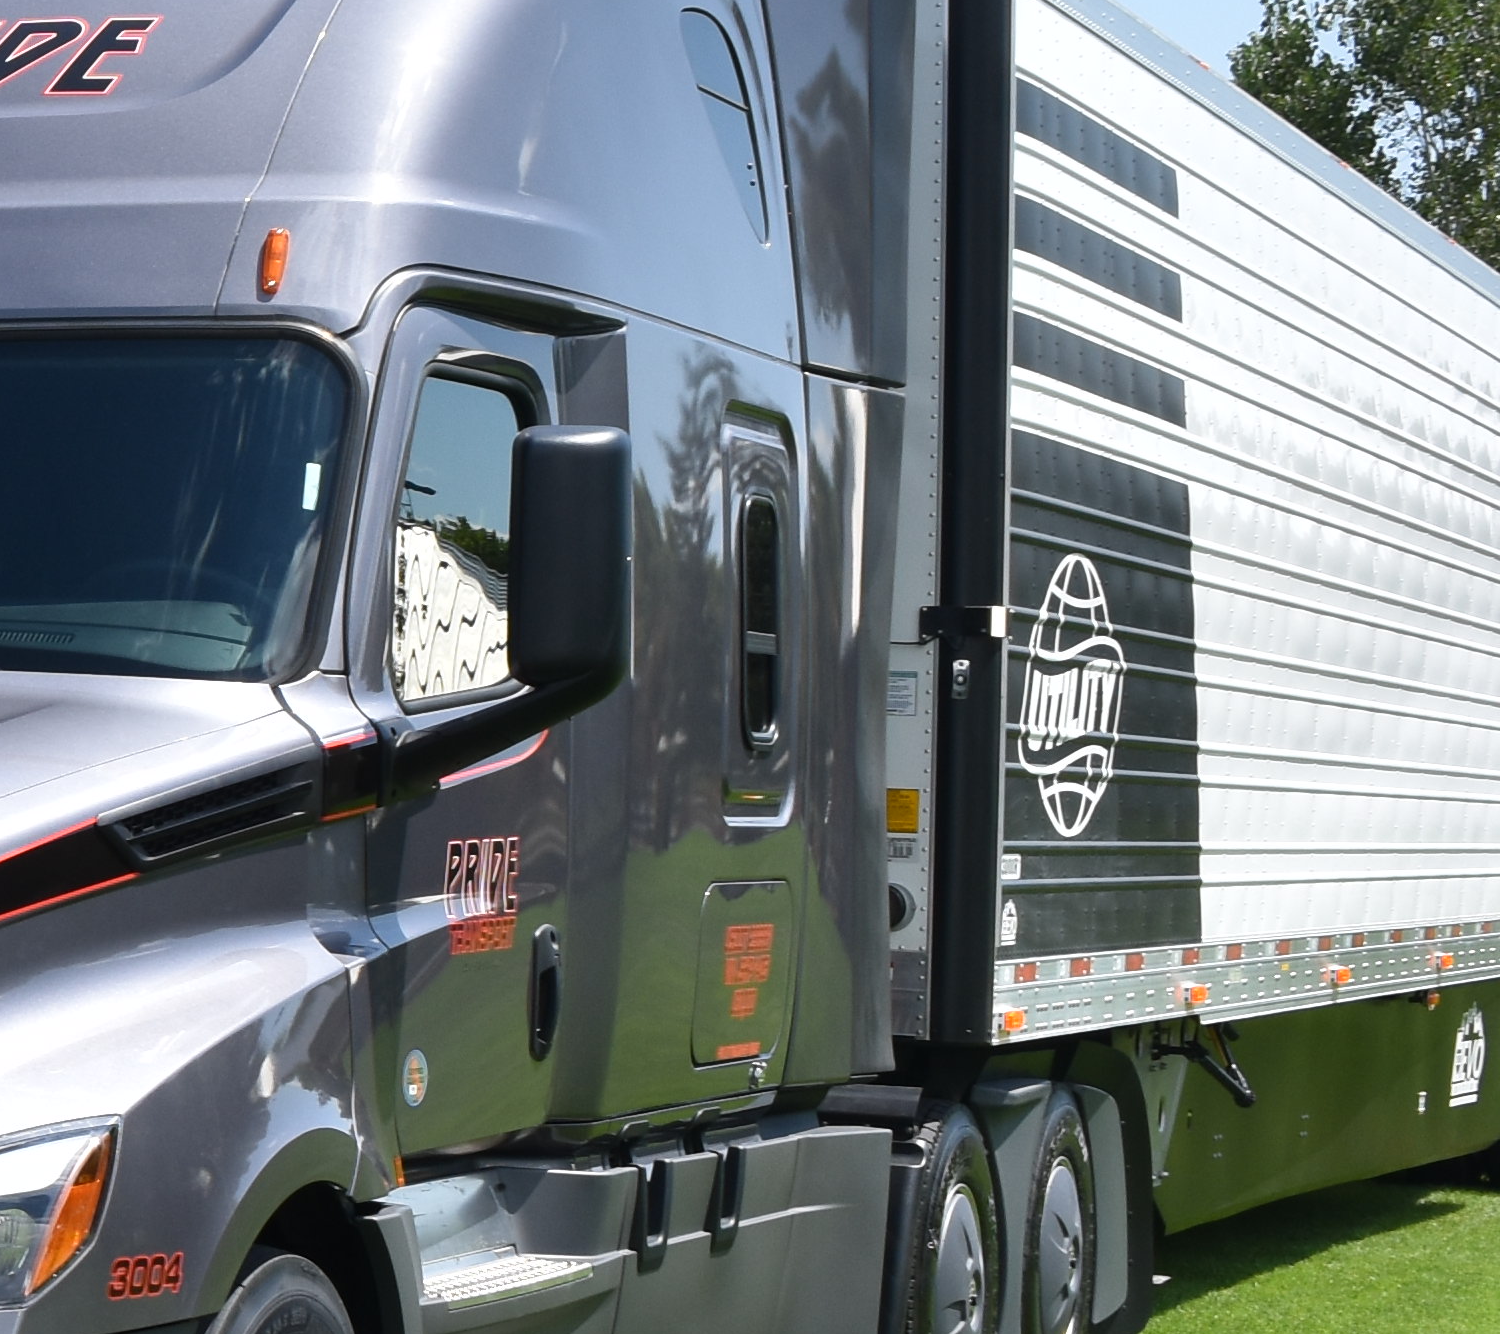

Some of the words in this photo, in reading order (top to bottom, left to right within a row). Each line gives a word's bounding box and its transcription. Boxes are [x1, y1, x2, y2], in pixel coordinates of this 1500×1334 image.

[1028, 658, 1121, 752] UTILITY
[443, 836, 520, 919] PRIDE
[107, 1251, 184, 1301] 3004
